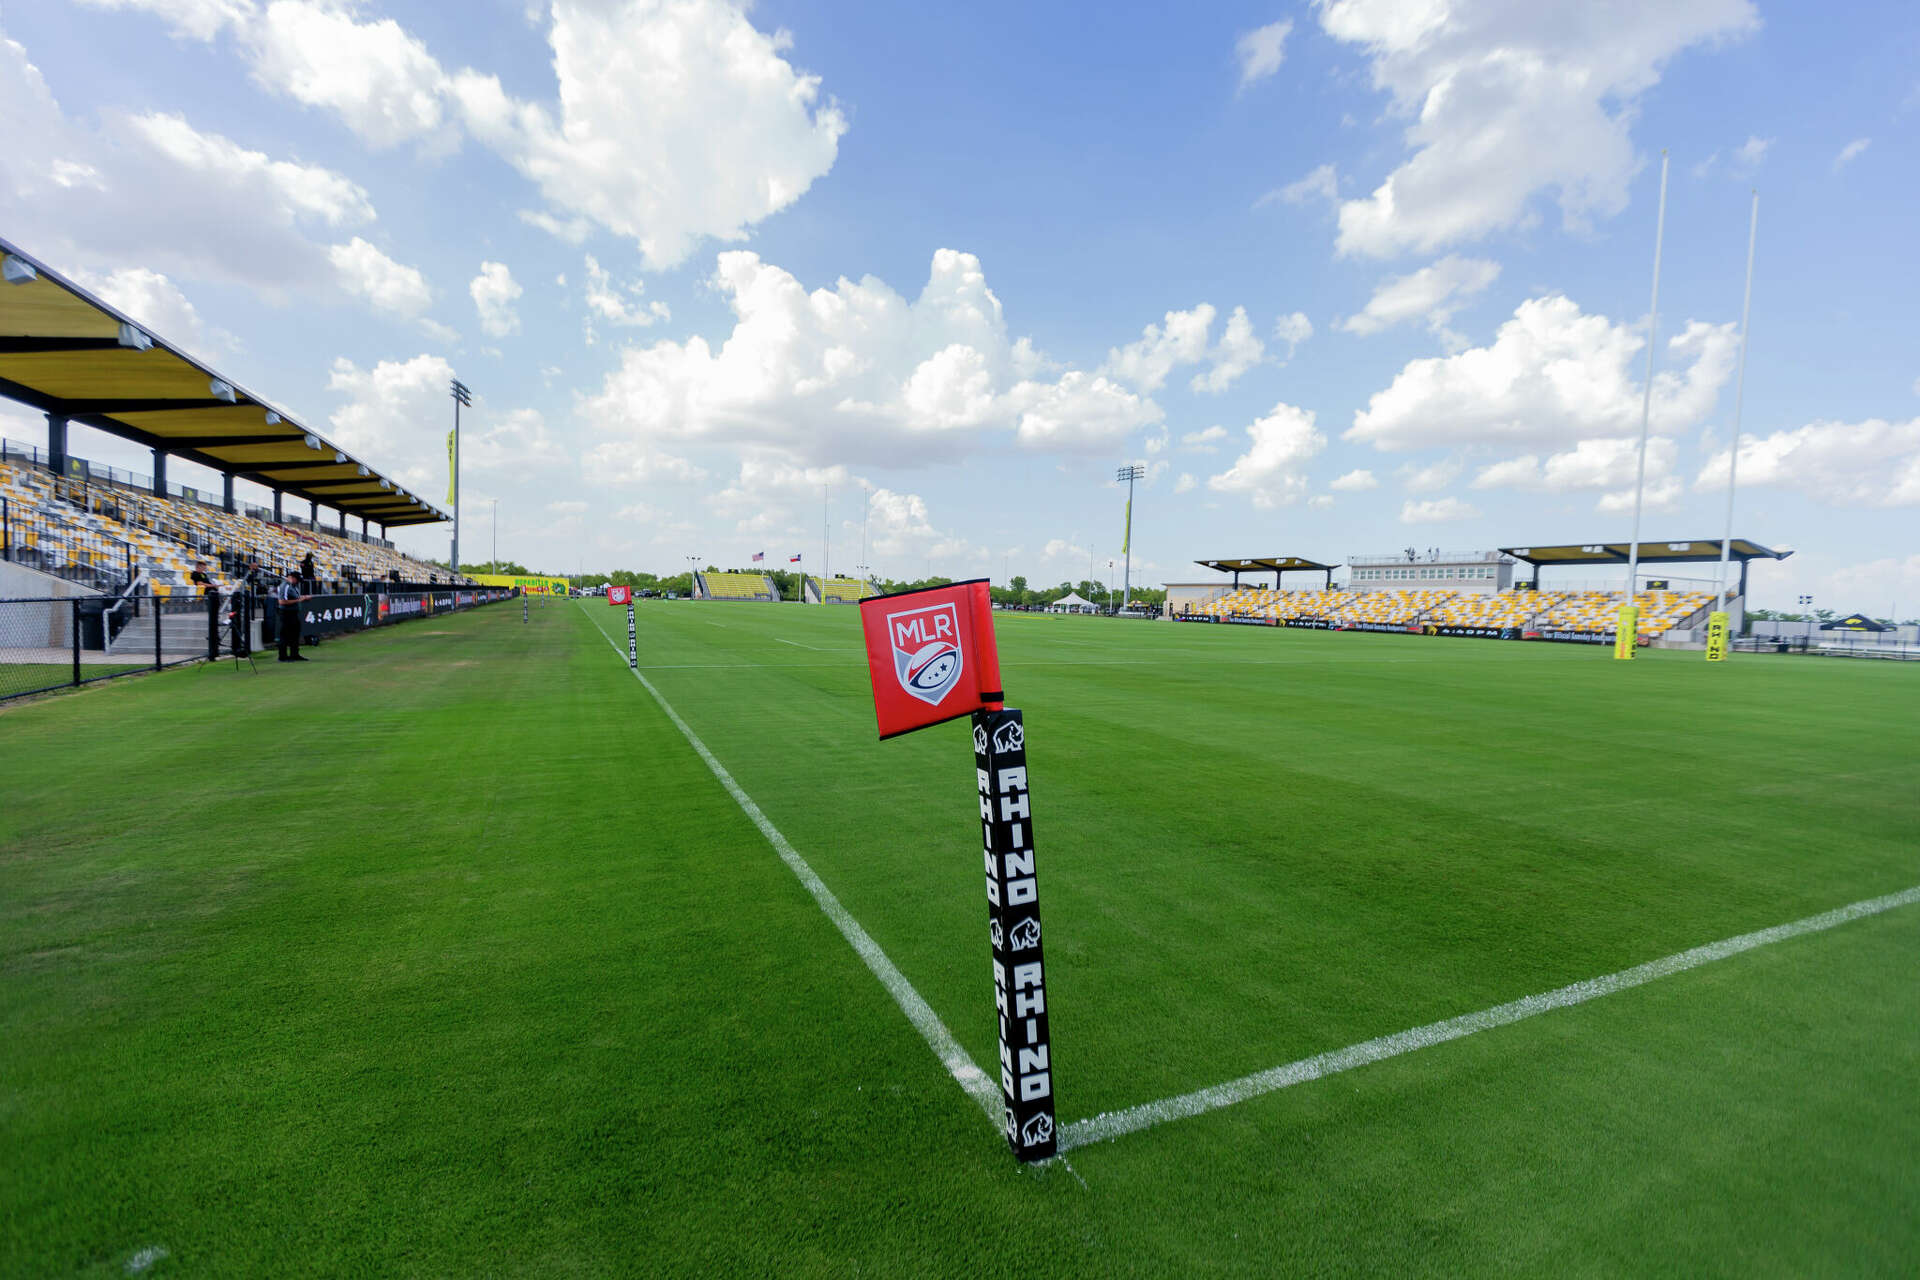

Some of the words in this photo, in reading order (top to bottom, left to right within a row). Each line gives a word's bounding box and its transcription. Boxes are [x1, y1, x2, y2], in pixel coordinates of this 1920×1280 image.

[305, 606, 362, 624] 4:40PM
[895, 614, 953, 647] MLR
[976, 767, 1000, 907] RHINO
[997, 766, 1038, 907] RHINO
[993, 957, 1014, 1100] RHINO
[1013, 960, 1050, 1102] RHINO
